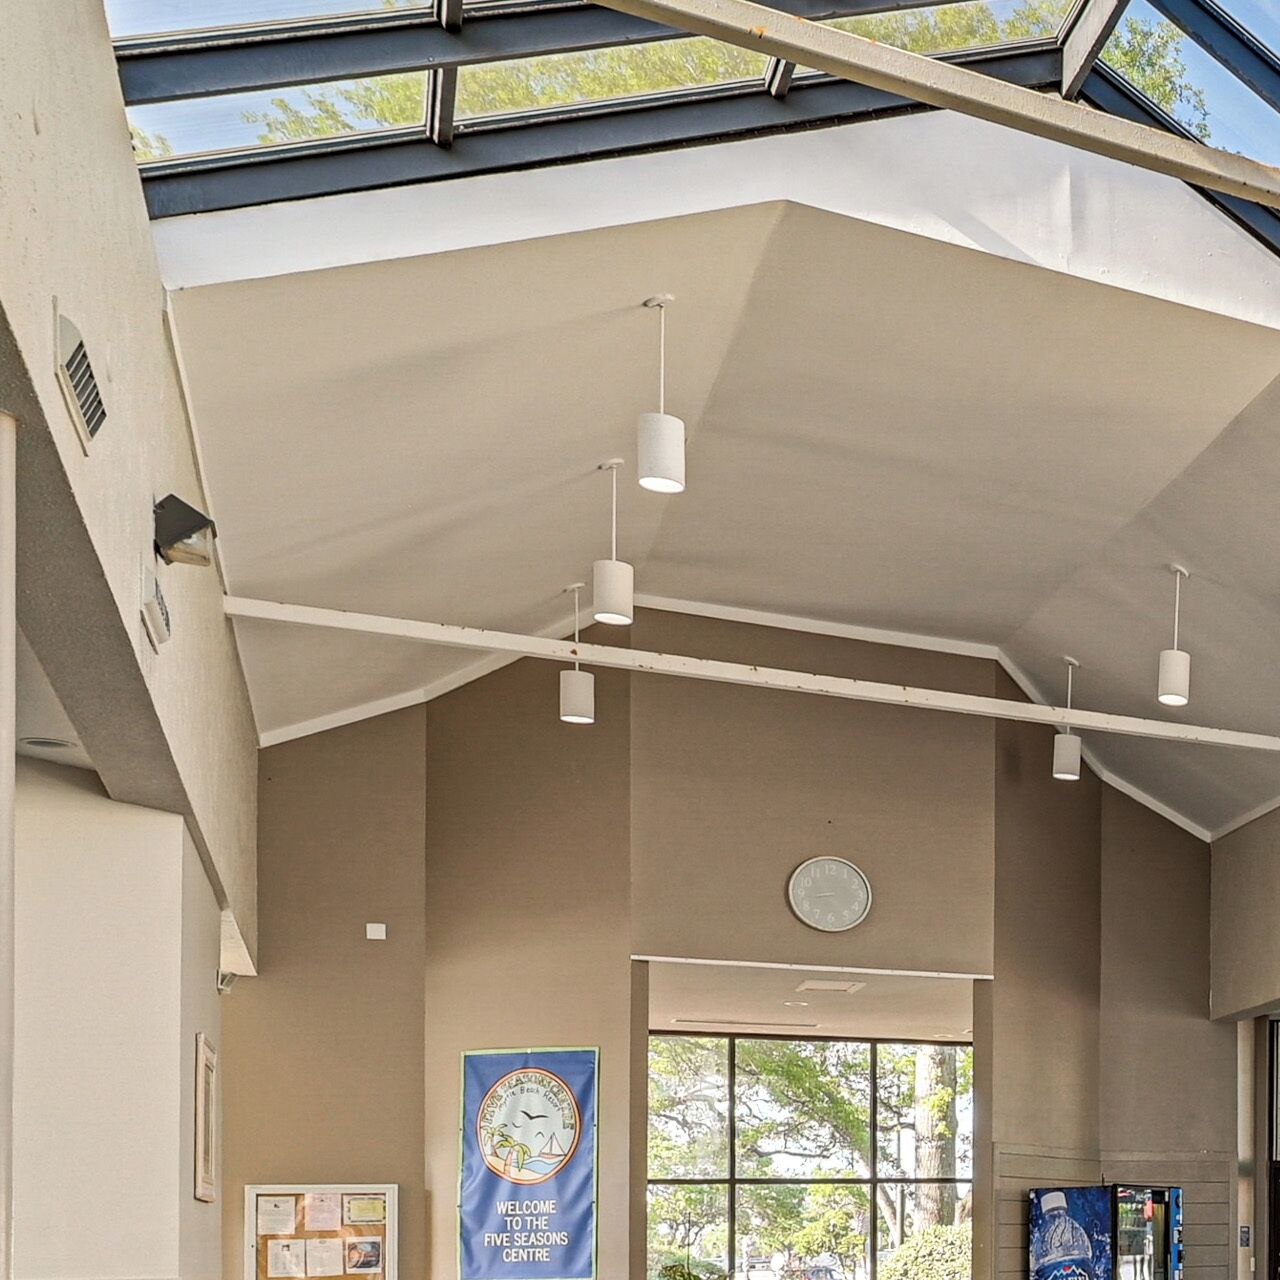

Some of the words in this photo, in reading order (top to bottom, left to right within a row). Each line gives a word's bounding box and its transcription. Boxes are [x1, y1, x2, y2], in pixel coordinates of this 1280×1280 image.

[497, 1200, 556, 1214] WELCOME
[504, 1217, 521, 1230] TO
[524, 1216, 549, 1230] THE
[484, 1234, 511, 1246] FIVE
[514, 1232, 568, 1246] SEASONS
[502, 1248, 550, 1262] CENTRE
